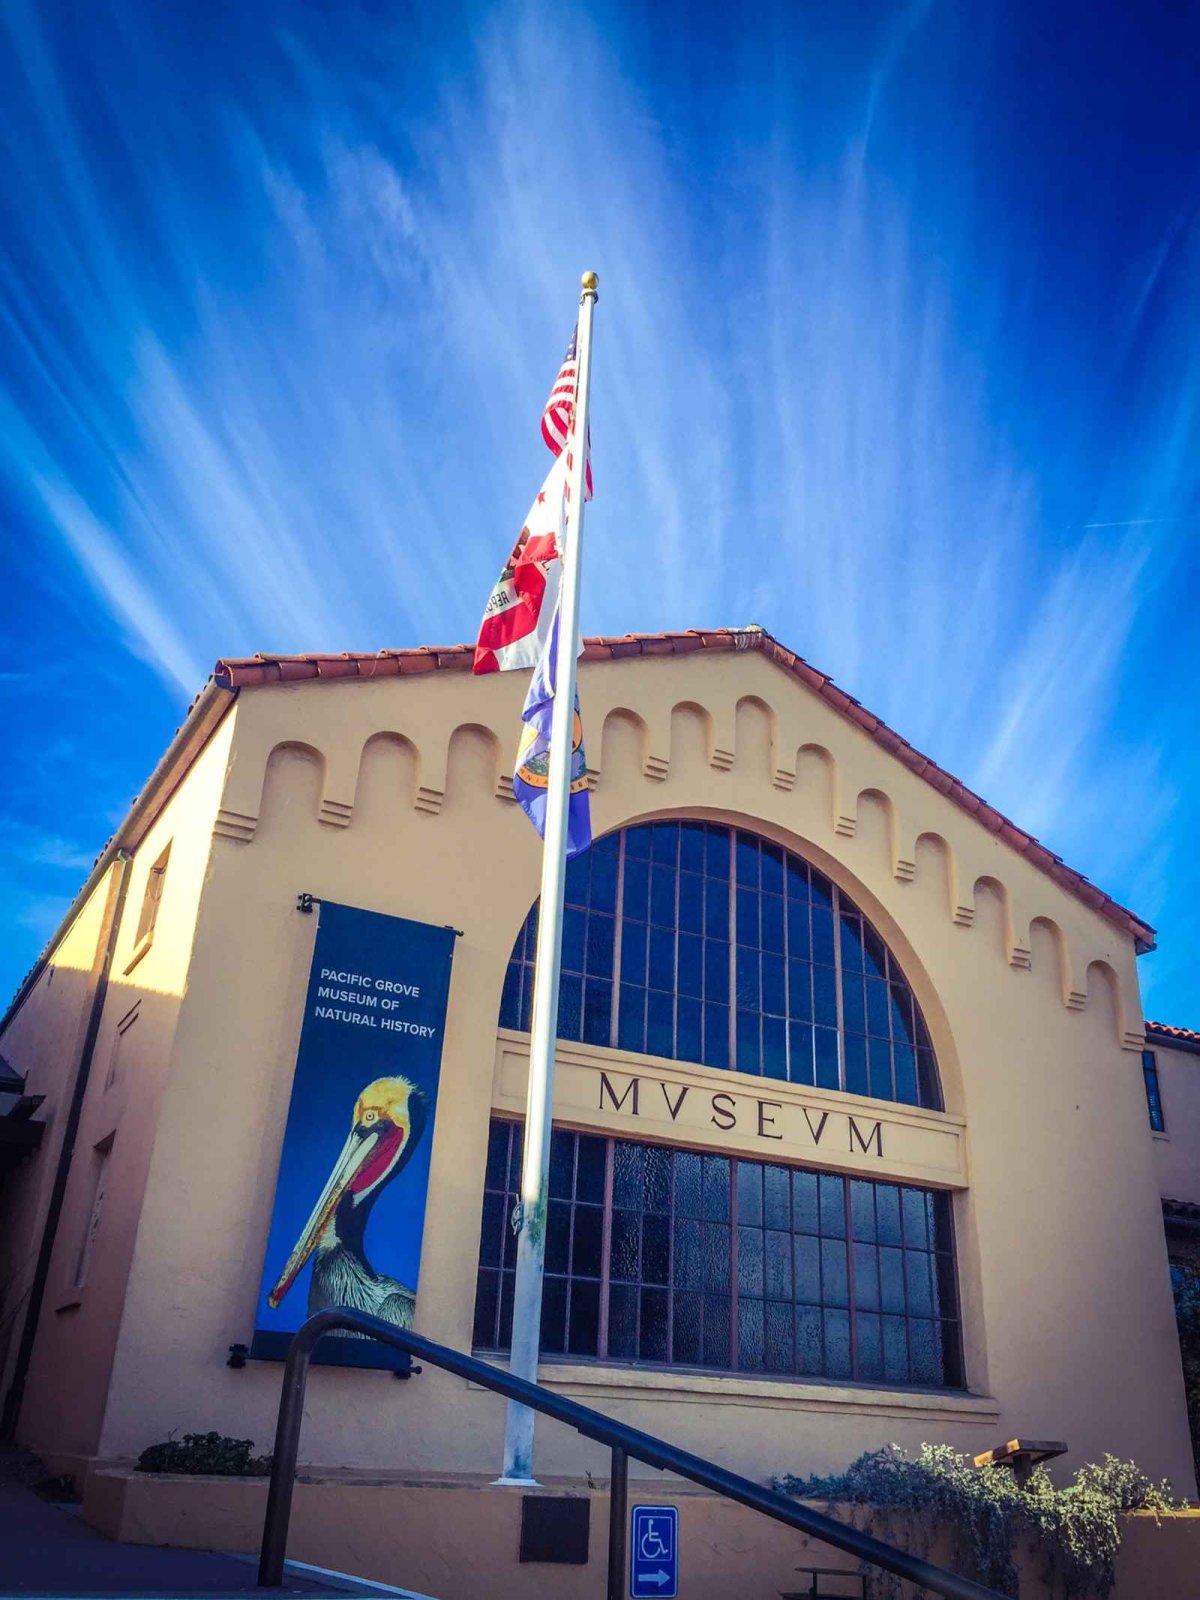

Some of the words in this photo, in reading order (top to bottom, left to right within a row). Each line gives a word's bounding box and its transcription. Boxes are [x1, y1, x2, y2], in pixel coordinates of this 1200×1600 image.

[317, 986, 378, 1007] MUSEUM
[381, 998, 400, 1011] OF
[320, 968, 372, 988] PACIFIC
[375, 979, 420, 998] GROVE
[314, 1006, 377, 1027] NATURAL
[381, 1017, 436, 1039] HISTORY
[599, 1071, 884, 1158] MVSEVM
